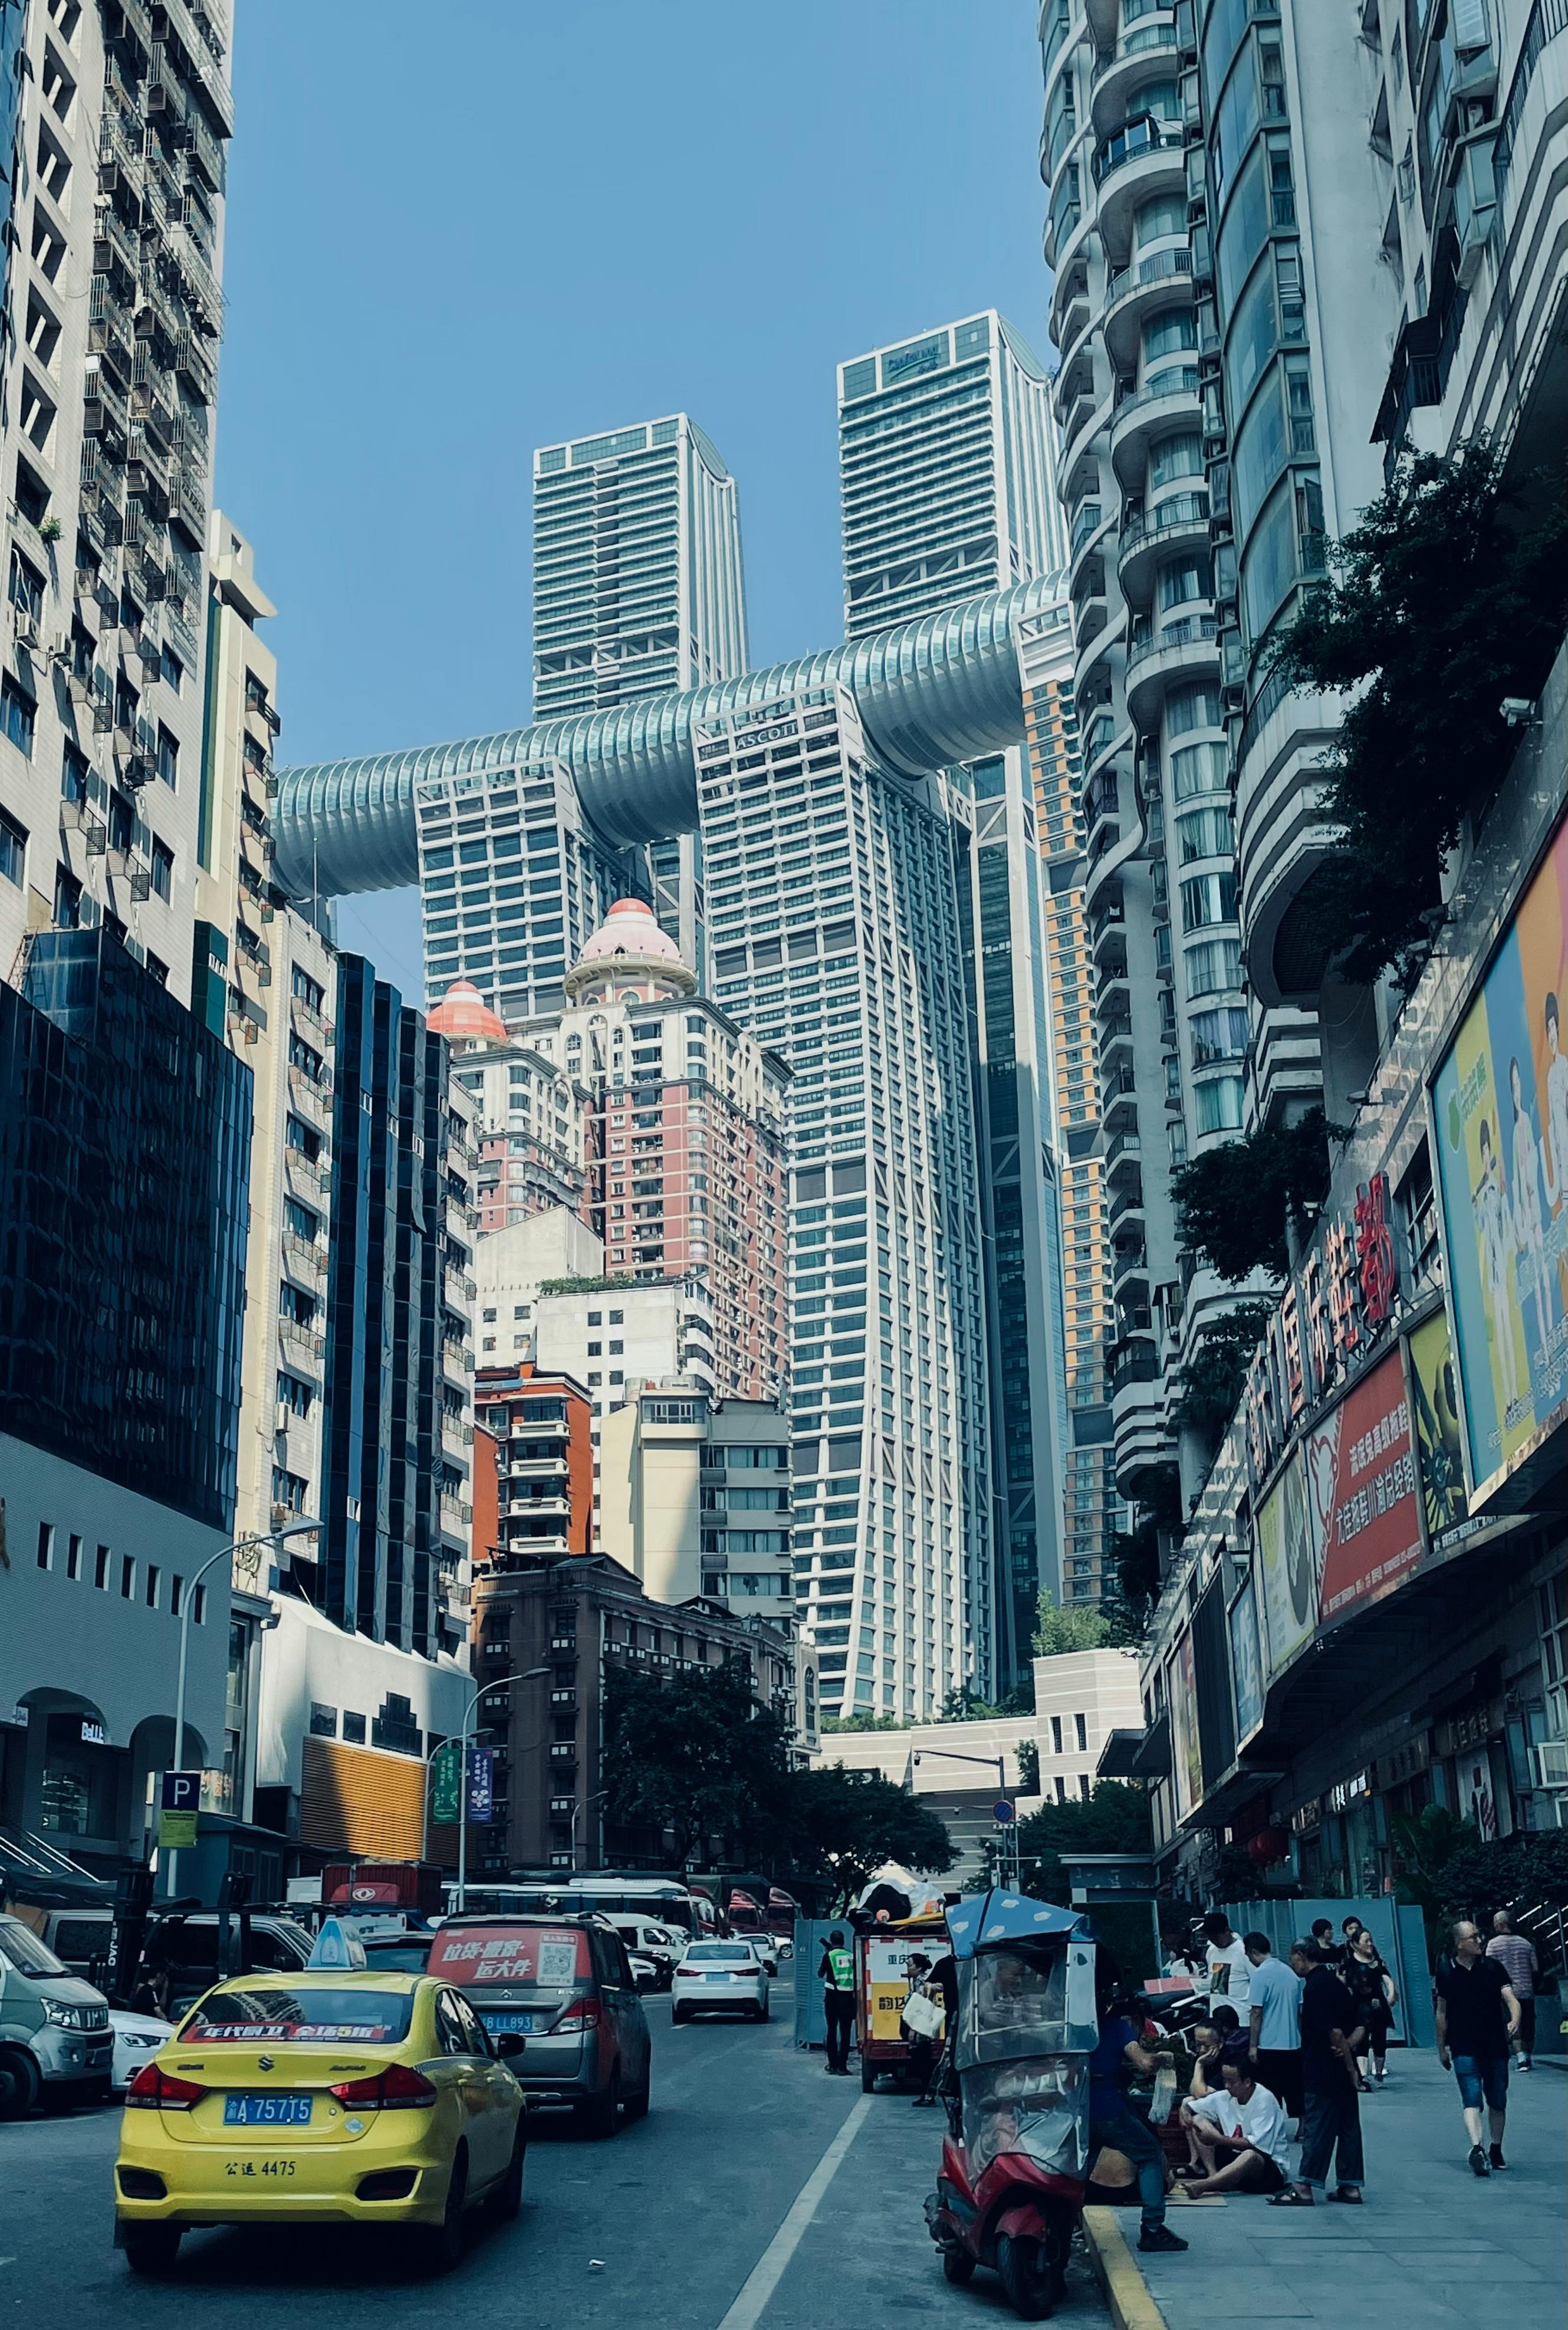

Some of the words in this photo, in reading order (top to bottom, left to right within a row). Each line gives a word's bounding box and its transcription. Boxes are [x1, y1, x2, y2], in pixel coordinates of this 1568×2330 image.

[736, 721, 797, 750] ASCOTT
[175, 1779, 190, 1805] P
[473, 1958, 532, 1980] 运大件
[225, 2162, 257, 2176] 公运
[261, 2161, 297, 2176] 4475
